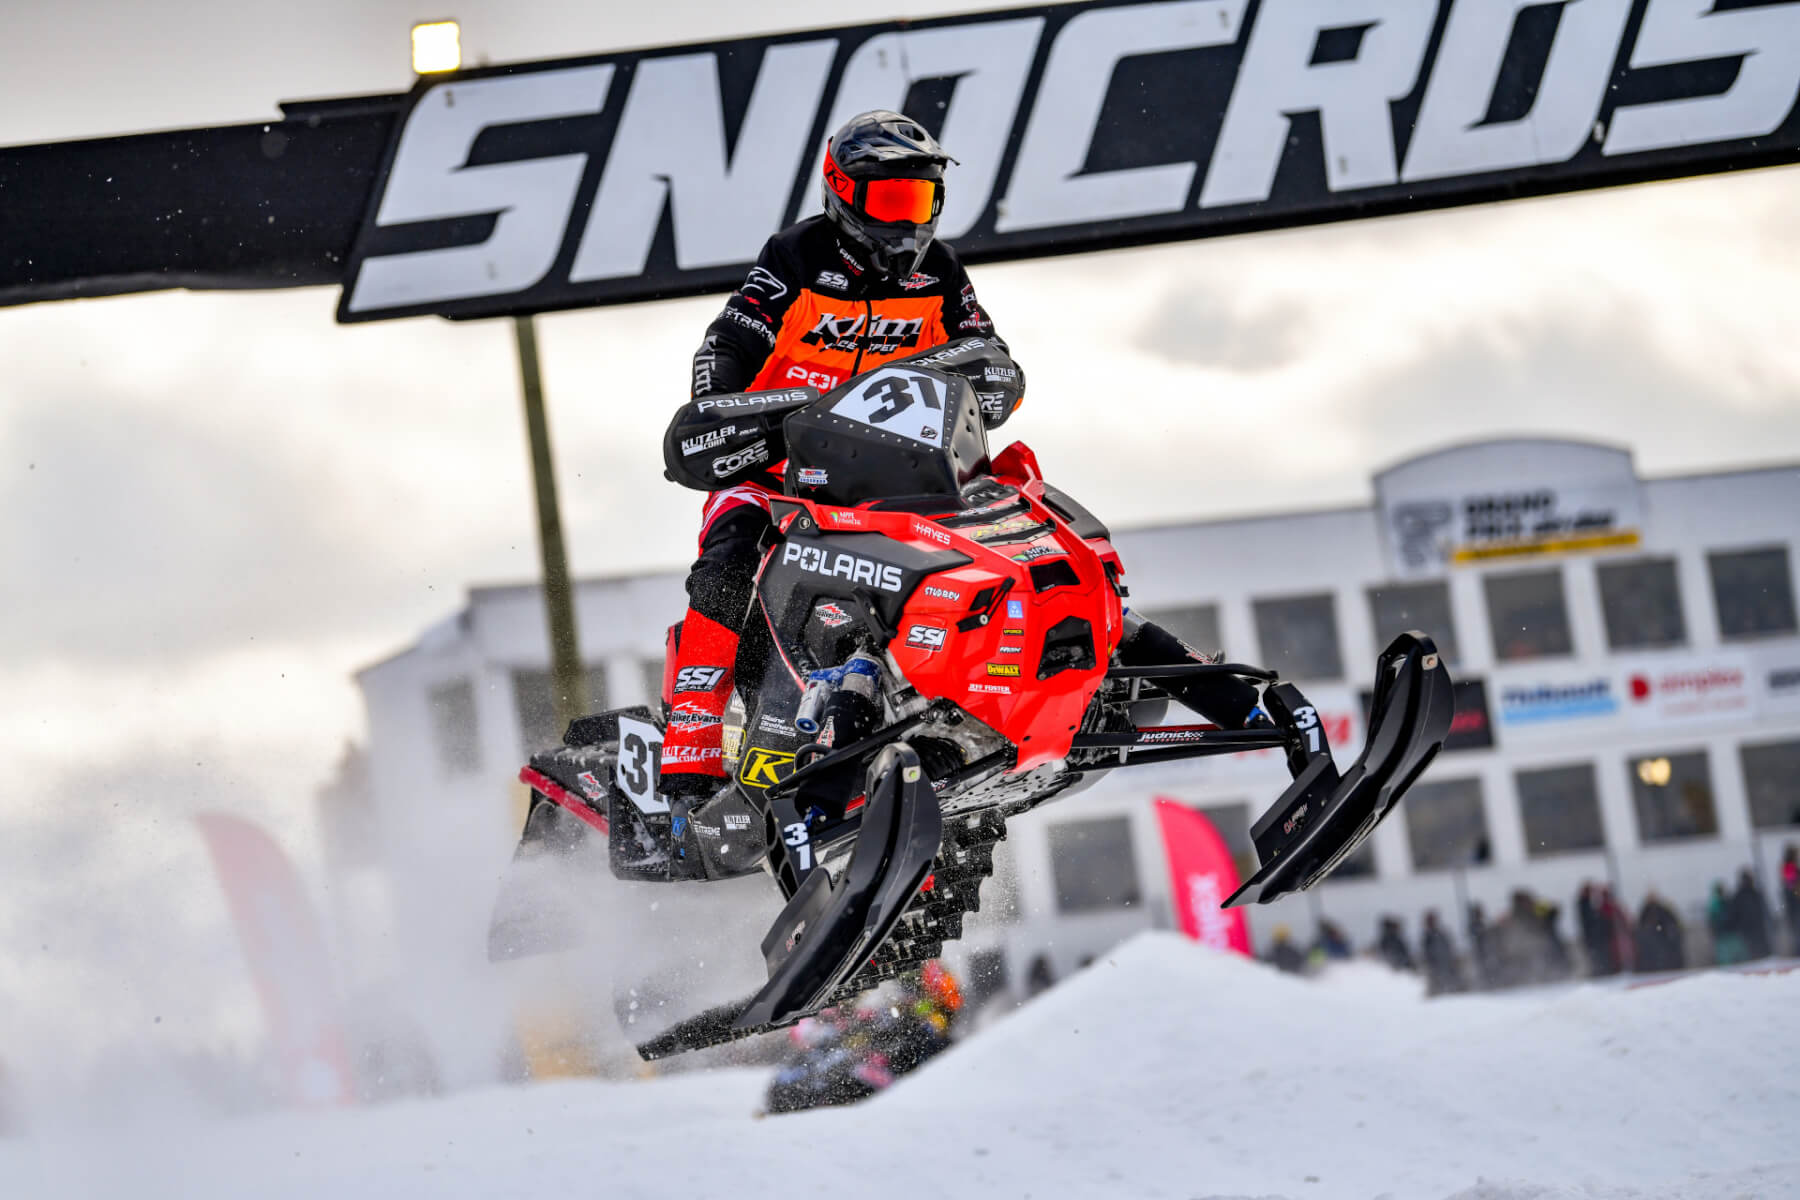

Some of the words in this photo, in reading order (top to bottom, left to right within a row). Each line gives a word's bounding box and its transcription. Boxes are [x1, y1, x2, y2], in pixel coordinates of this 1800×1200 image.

[818, 271, 849, 287] SSI
[810, 313, 923, 338] Klim
[910, 339, 985, 367] OLARIS
[697, 392, 808, 413] POLARIS
[863, 375, 942, 425] 31
[681, 425, 737, 450] KUTZLER
[712, 440, 769, 478] CORE
[913, 522, 951, 545] HAYES
[782, 542, 903, 593] POLARIS
[908, 626, 946, 647] SSI
[676, 667, 726, 687] SSI
[744, 753, 794, 784] K
